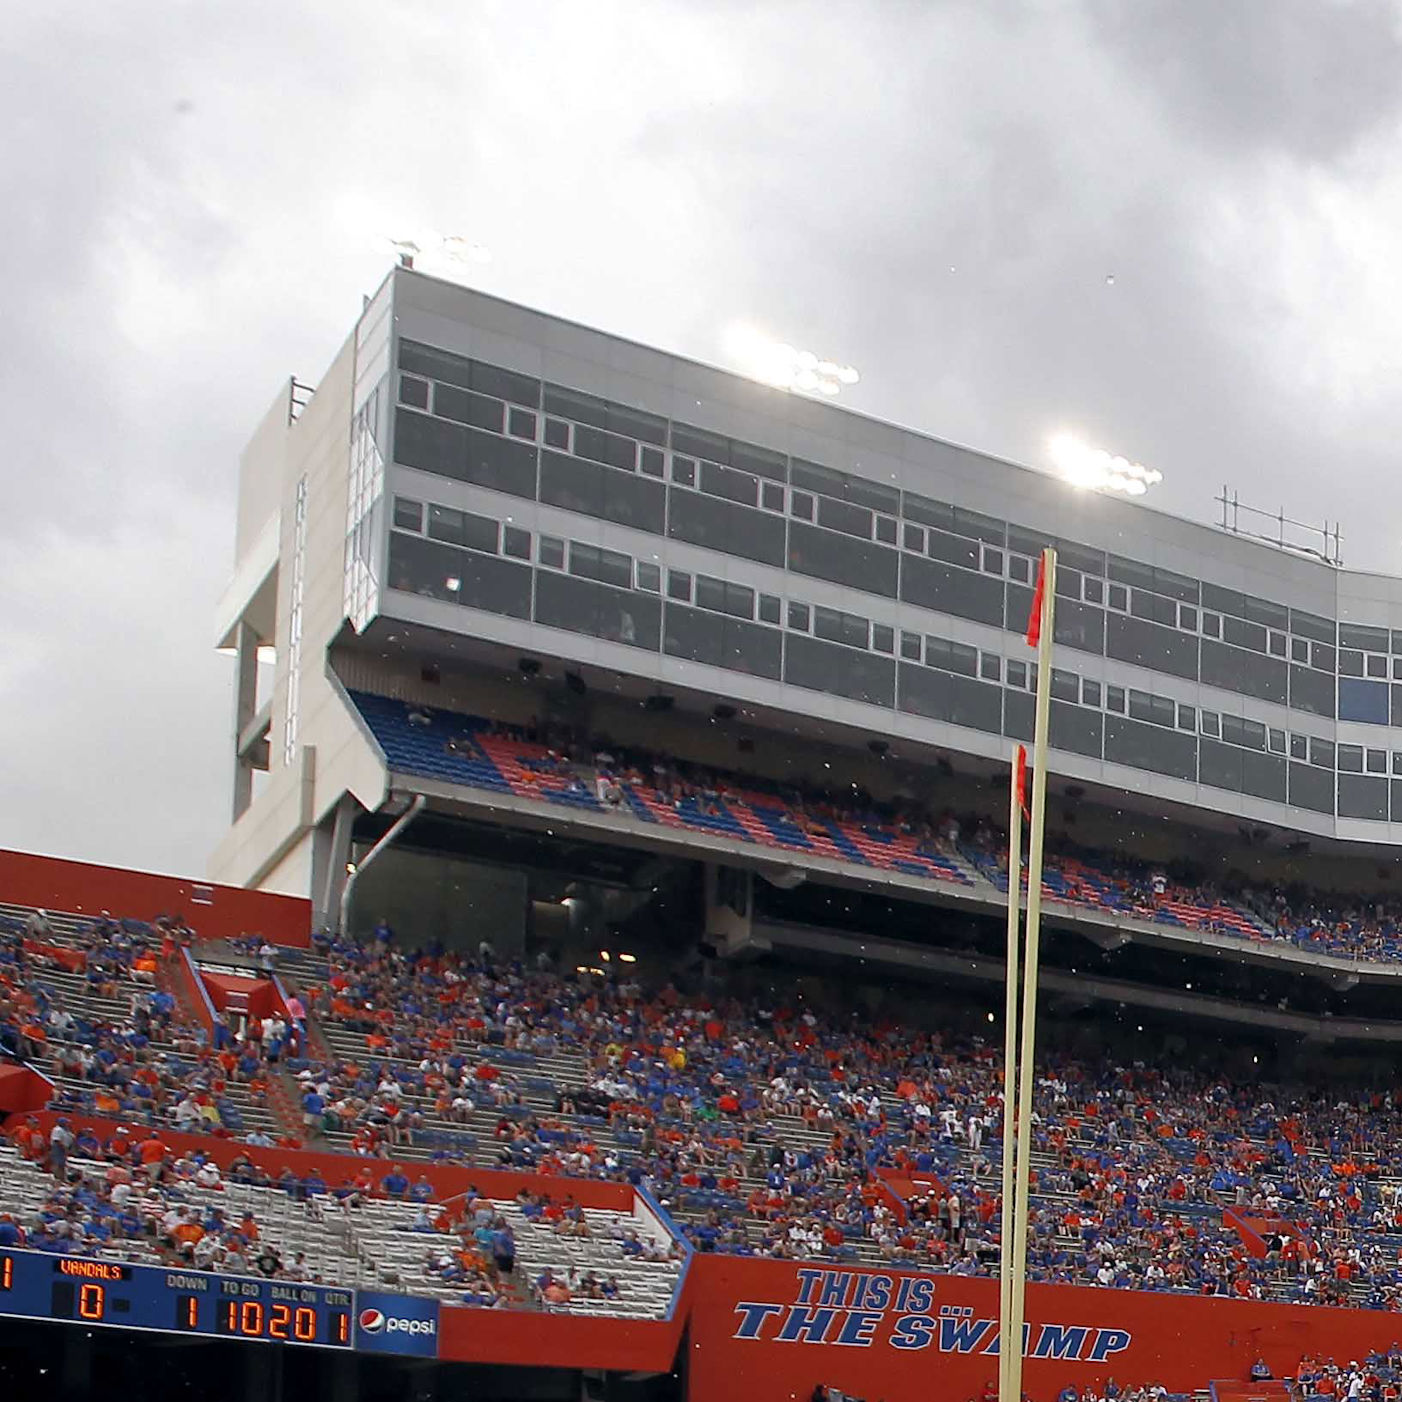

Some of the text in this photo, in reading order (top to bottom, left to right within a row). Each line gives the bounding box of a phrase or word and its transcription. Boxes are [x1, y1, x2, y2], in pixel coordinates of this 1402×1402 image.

[60, 1259, 123, 1280] VANDALS
[167, 1275, 208, 1292] DOWN
[222, 1280, 260, 1298] TO GO
[271, 1286, 298, 1301] BALL
[795, 1268, 893, 1312] THIS
[80, 1283, 104, 1319] 0
[188, 1296, 198, 1329] 1
[339, 1313, 348, 1343] 1
[386, 1317, 436, 1336] pepsi
[732, 1301, 885, 1347] THE
